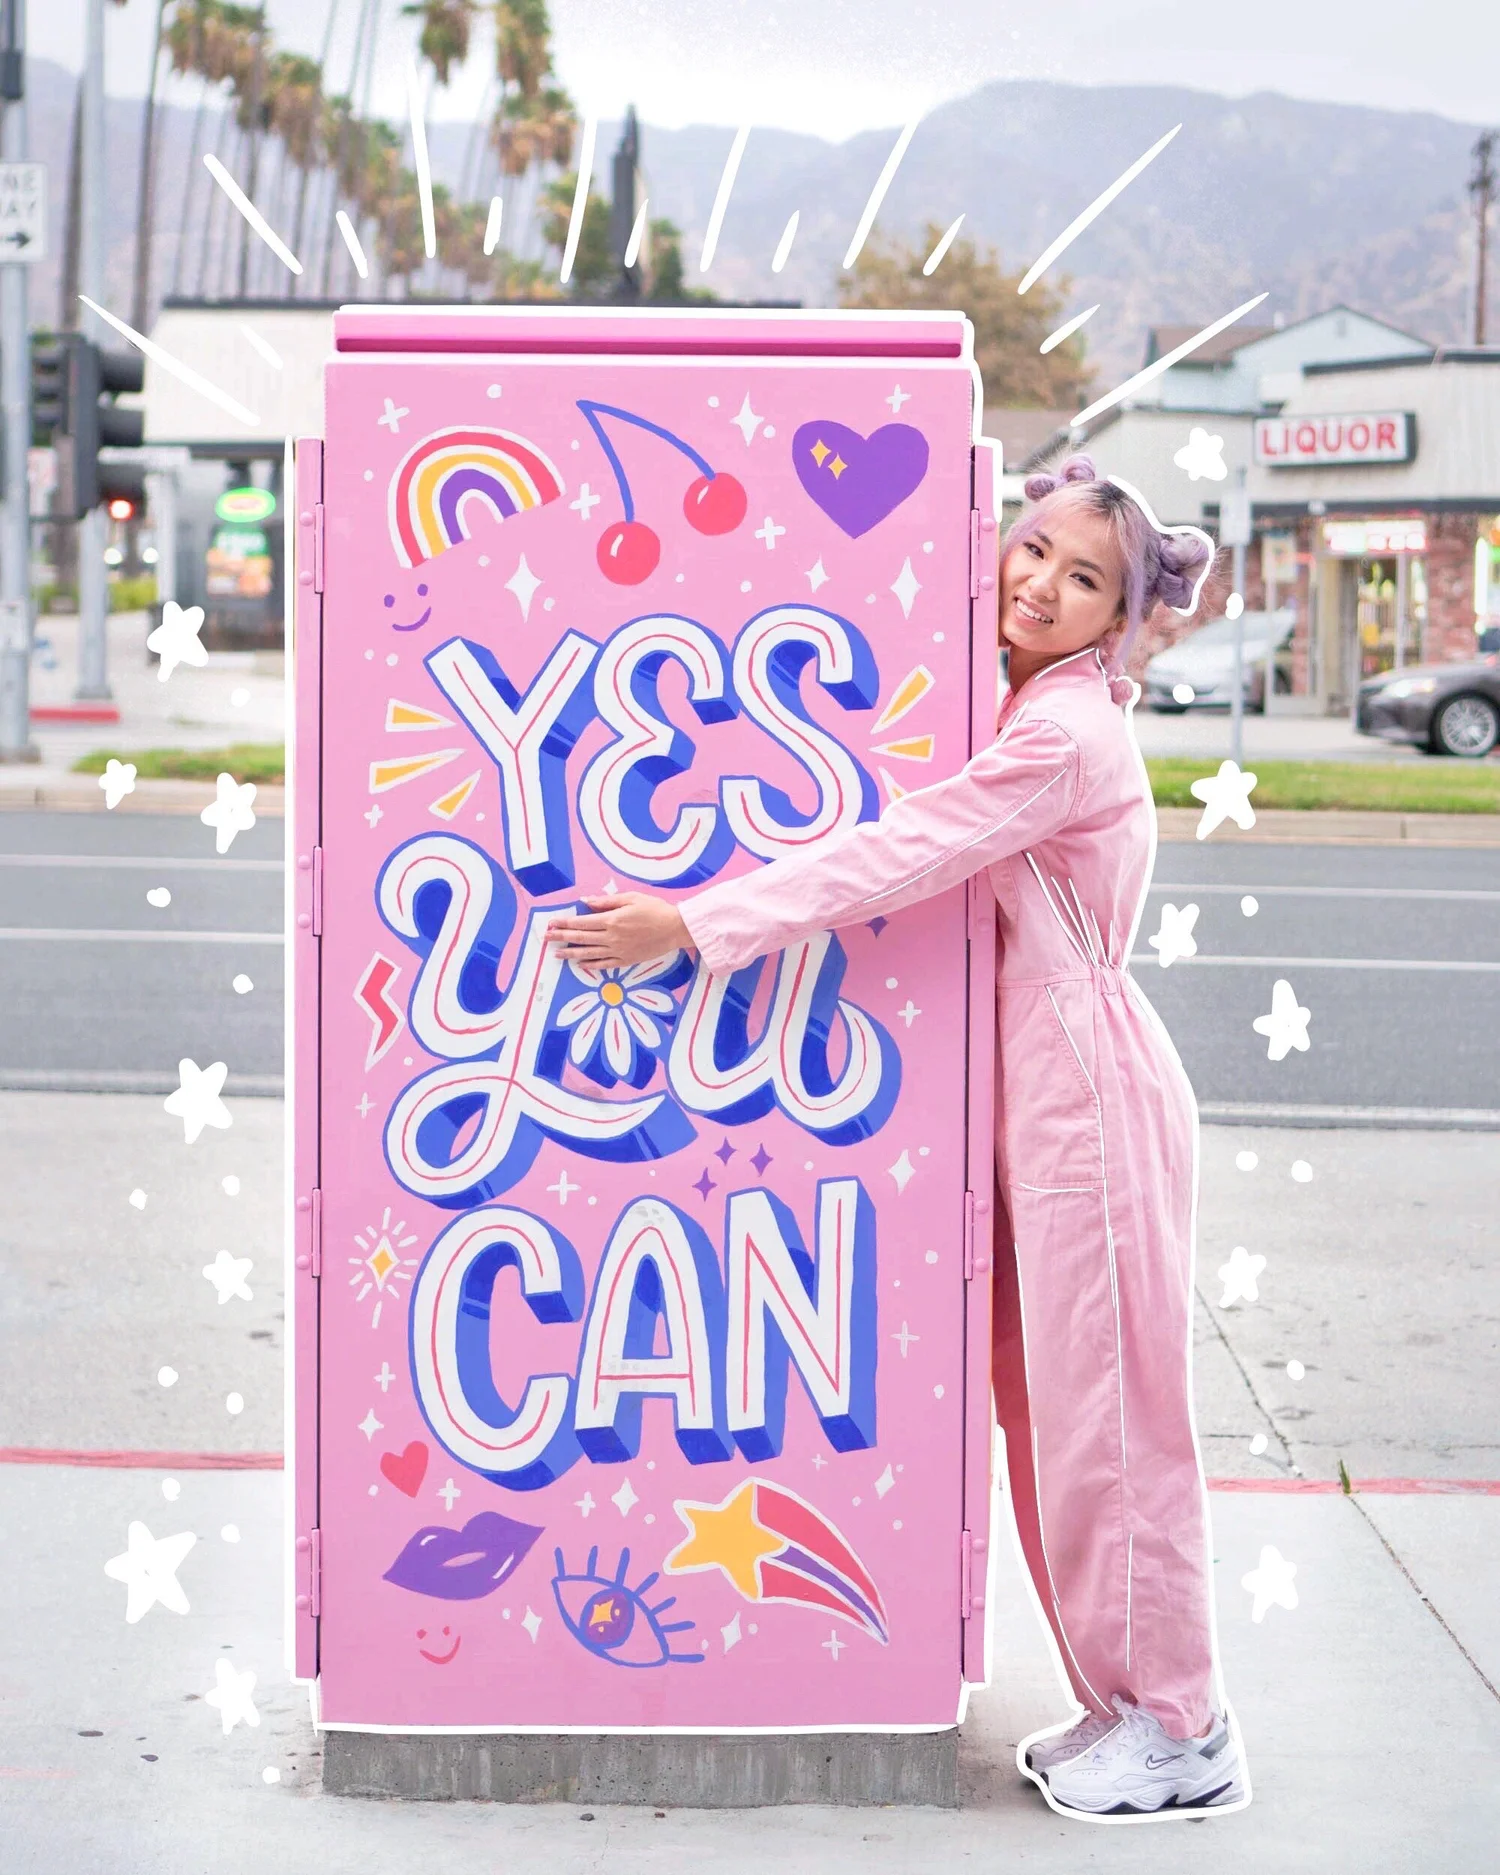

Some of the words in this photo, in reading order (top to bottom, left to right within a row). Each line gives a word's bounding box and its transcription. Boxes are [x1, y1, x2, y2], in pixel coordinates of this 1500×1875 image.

[0, 170, 37, 194] NE
[0, 197, 38, 217] AY
[1262, 420, 1397, 455] LIQUOR
[423, 603, 879, 896] YES
[408, 1176, 877, 1492] CAN
